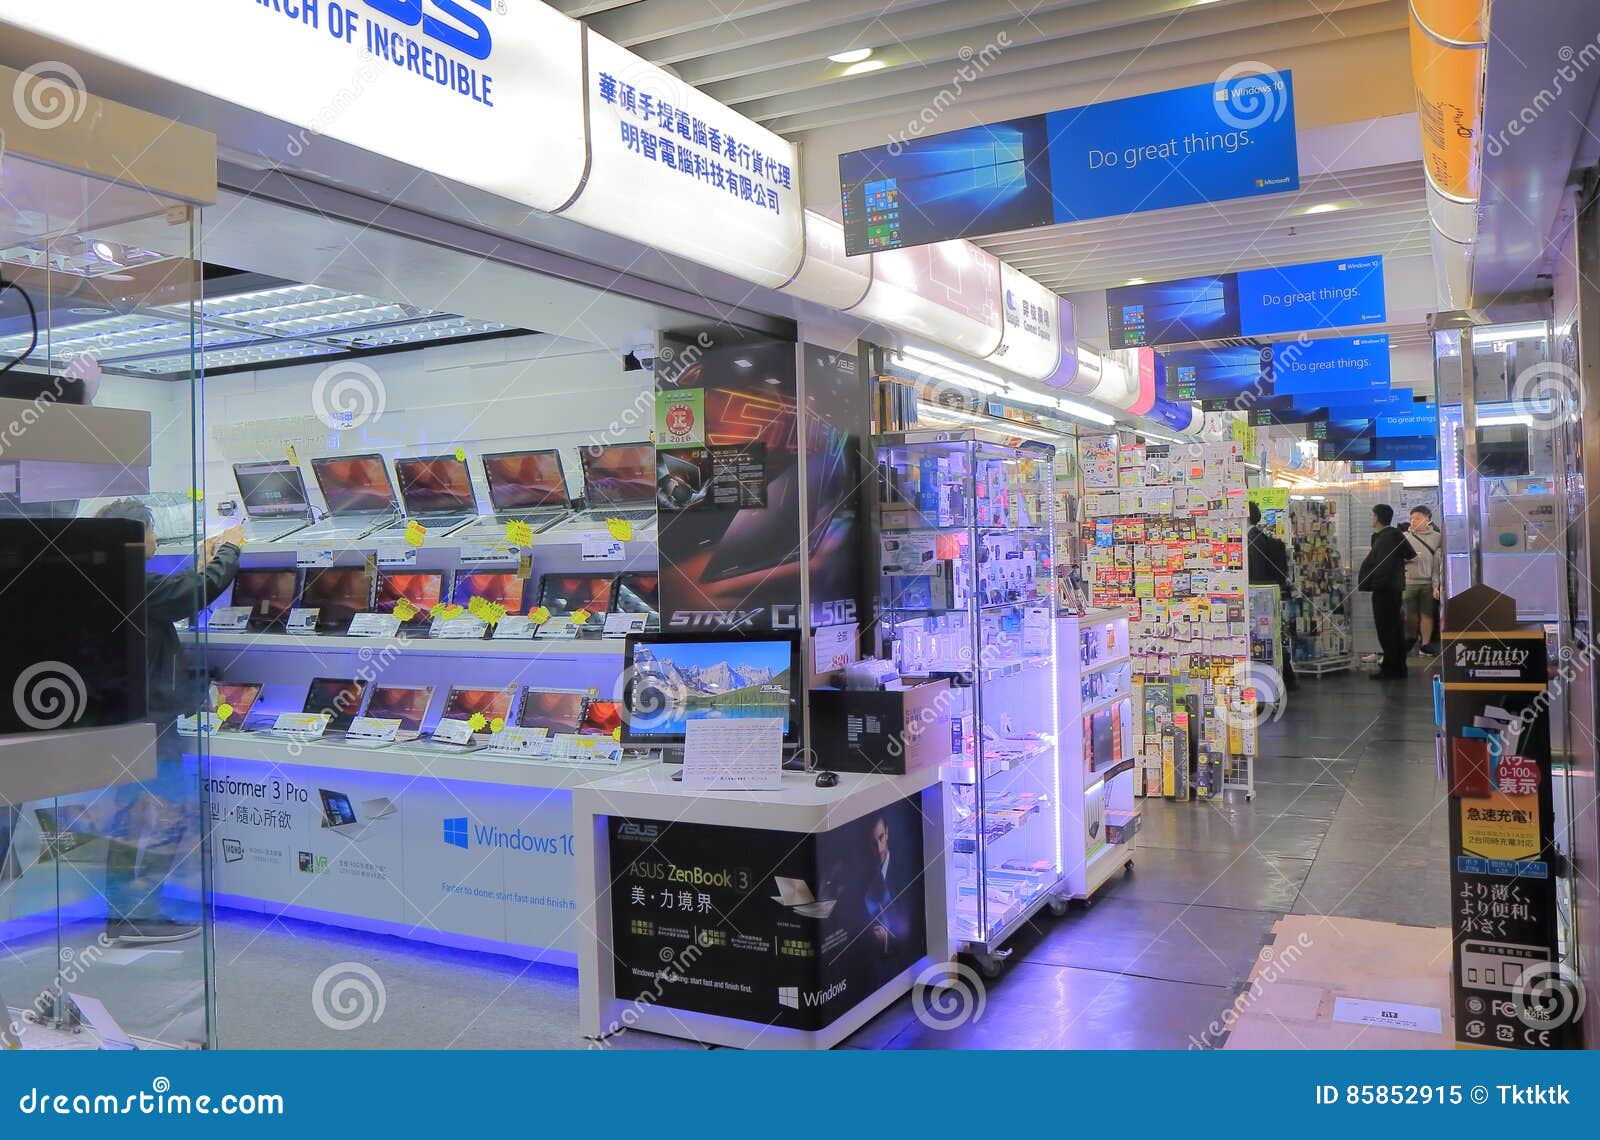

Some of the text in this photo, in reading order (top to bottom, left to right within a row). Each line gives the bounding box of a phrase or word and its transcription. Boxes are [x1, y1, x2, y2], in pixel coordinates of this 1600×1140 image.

[328, 2, 358, 43] OF
[366, 20, 493, 107] INCREDIBLE
[1230, 80, 1284, 98] Windows 10
[599, 71, 792, 190] 華碩手提電腦香港行貨代理
[1088, 129, 1255, 169] Do great things.
[620, 120, 780, 215] 明智電腦科技有限公司
[1262, 287, 1361, 307] Do great things.
[1291, 362, 1306, 372] Do
[1309, 359, 1335, 373] great
[1399, 416, 1416, 426] great
[669, 434, 692, 443] 2016
[669, 607, 765, 632] STRIX
[1500, 755, 1537, 765] パワー
[272, 781, 281, 799] 3
[286, 783, 308, 802] Pro
[1500, 778, 1537, 795] 表示
[474, 824, 557, 854] Windows
[617, 823, 659, 836] ASUS
[630, 861, 748, 889] ASUS ZenBook 3
[464, 886, 472, 896] to
[496, 889, 513, 900] start
[514, 893, 532, 904] fast
[531, 896, 545, 906] and
[546, 896, 568, 909] finish
[1460, 882, 1531, 903] より薄く、
[1460, 899, 1537, 922] より便利、
[1460, 918, 1507, 936] 小さく
[803, 978, 848, 1007] Windows
[1524, 1029, 1550, 1047] CE
